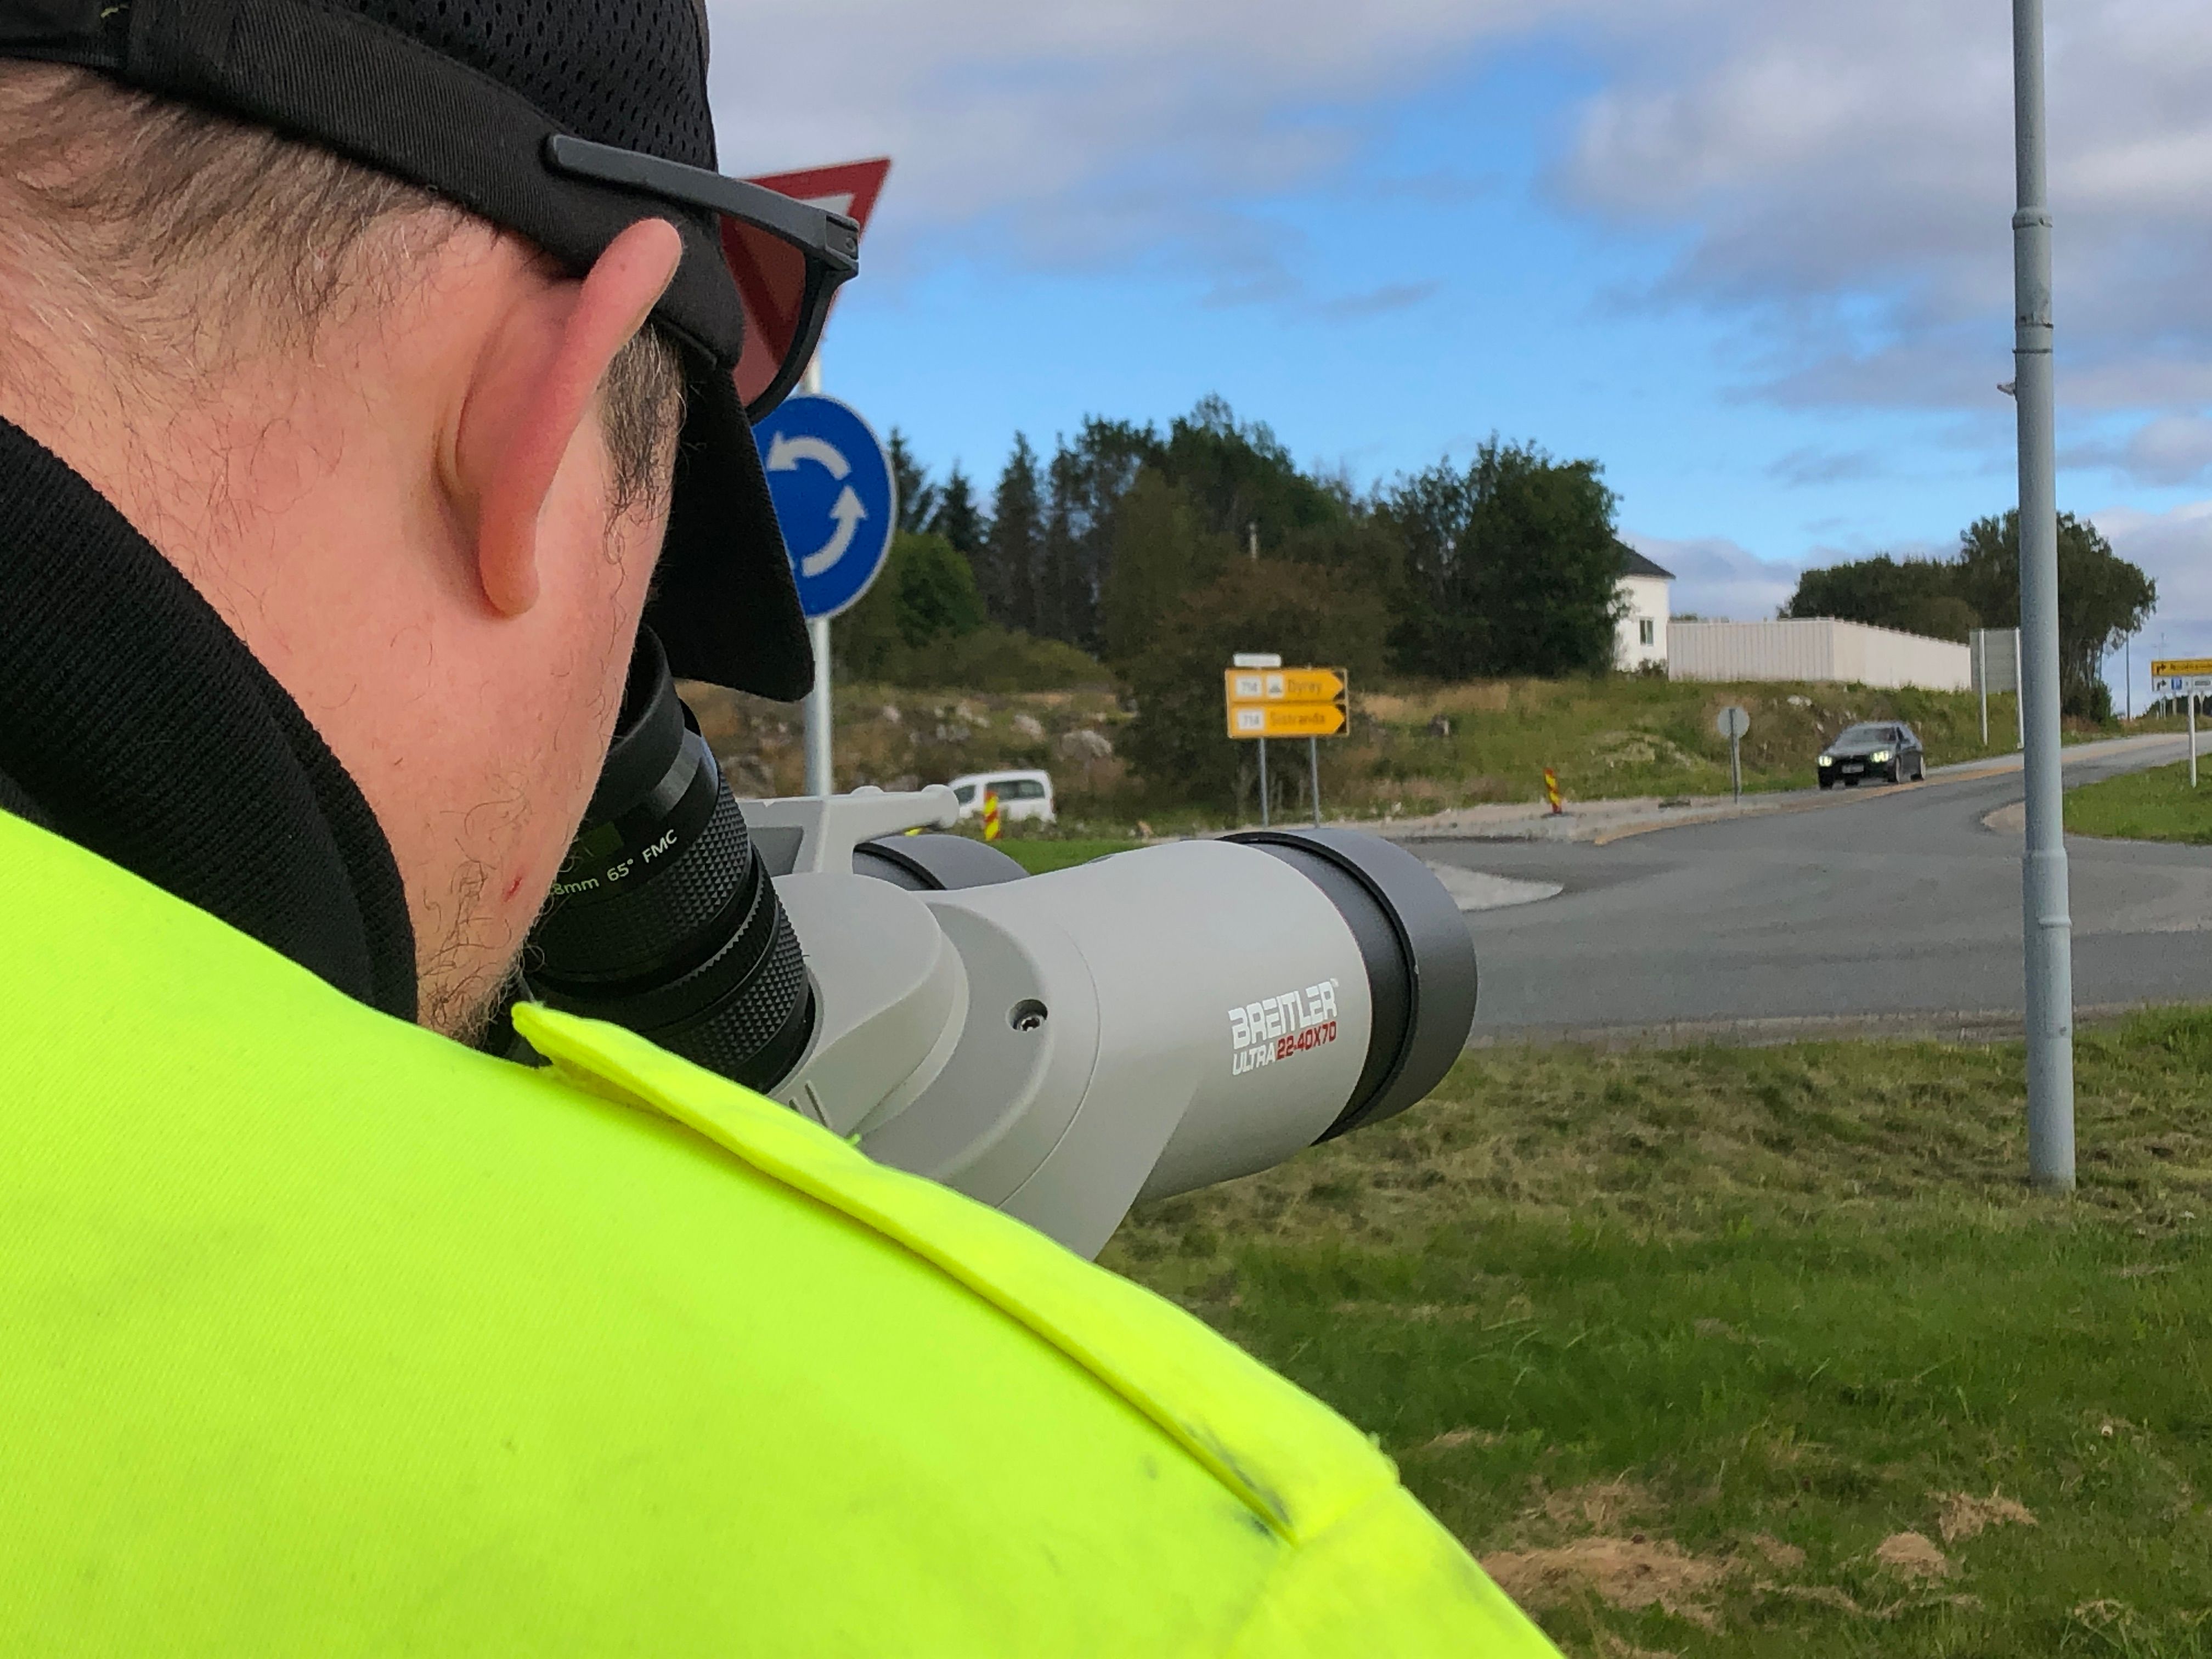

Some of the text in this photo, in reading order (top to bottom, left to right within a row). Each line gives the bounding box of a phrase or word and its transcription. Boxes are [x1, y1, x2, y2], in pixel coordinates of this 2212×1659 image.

[607, 859, 634, 882] 65°
[642, 829, 678, 863] FMC
[1228, 981, 1338, 1050] BREITLER
[1232, 1042, 1276, 1076] ULTRA
